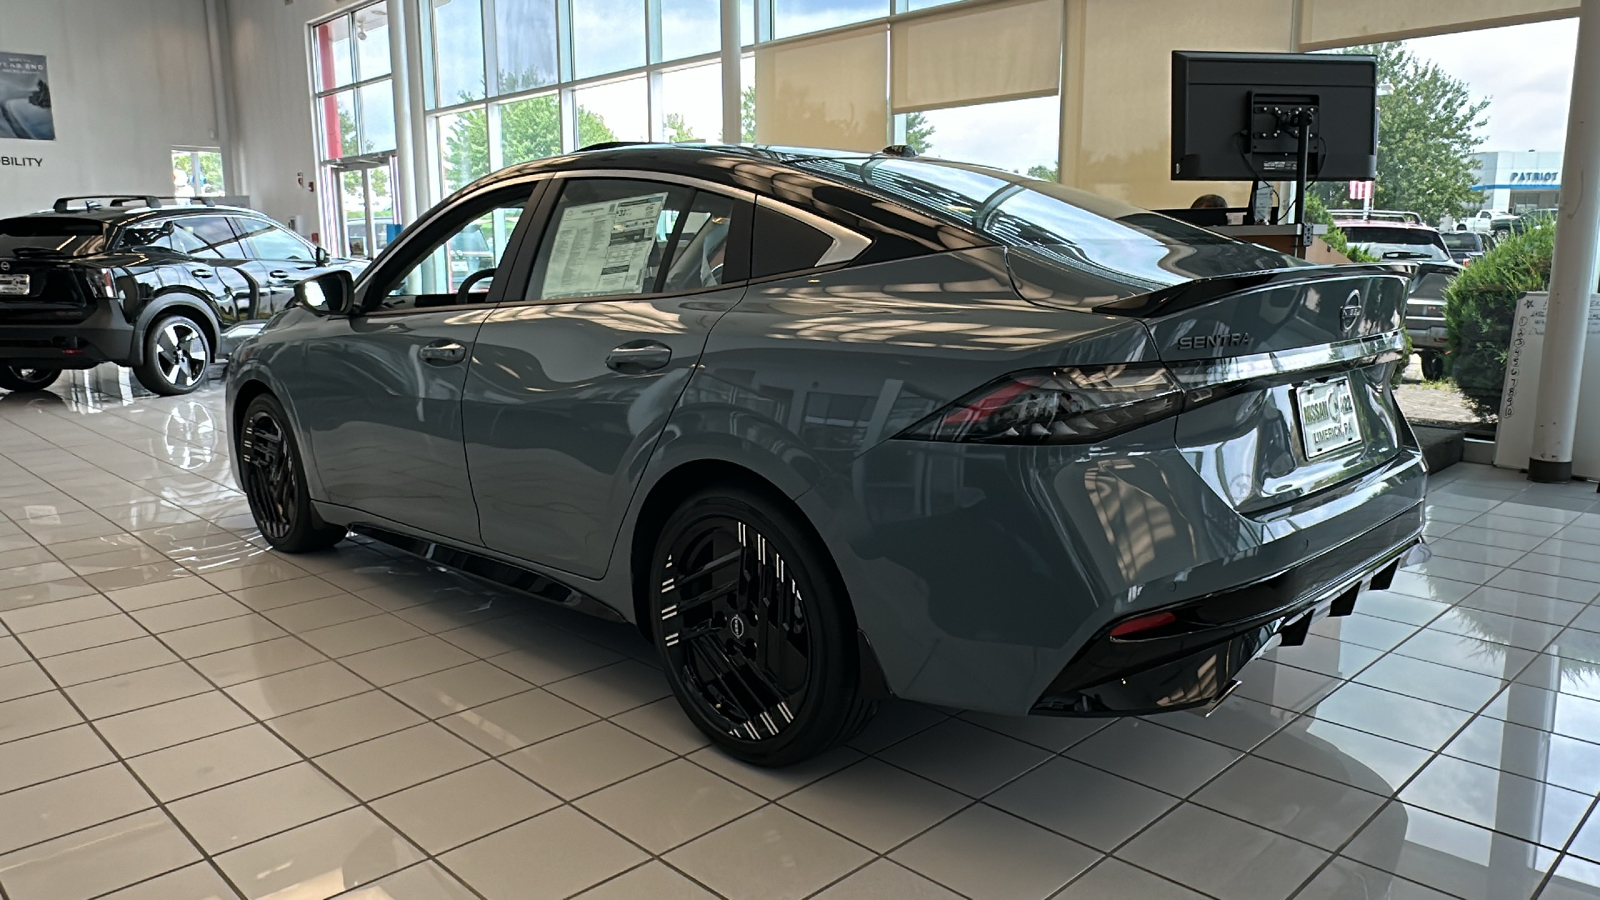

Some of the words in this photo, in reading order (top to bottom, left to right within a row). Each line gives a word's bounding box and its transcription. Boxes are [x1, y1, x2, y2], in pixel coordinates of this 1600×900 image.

[0, 156, 43, 167] BILITY
[1510, 172, 1558, 181] PATRIOT
[1178, 332, 1249, 350] SENTRA
[1303, 401, 1329, 423] NISSAN
